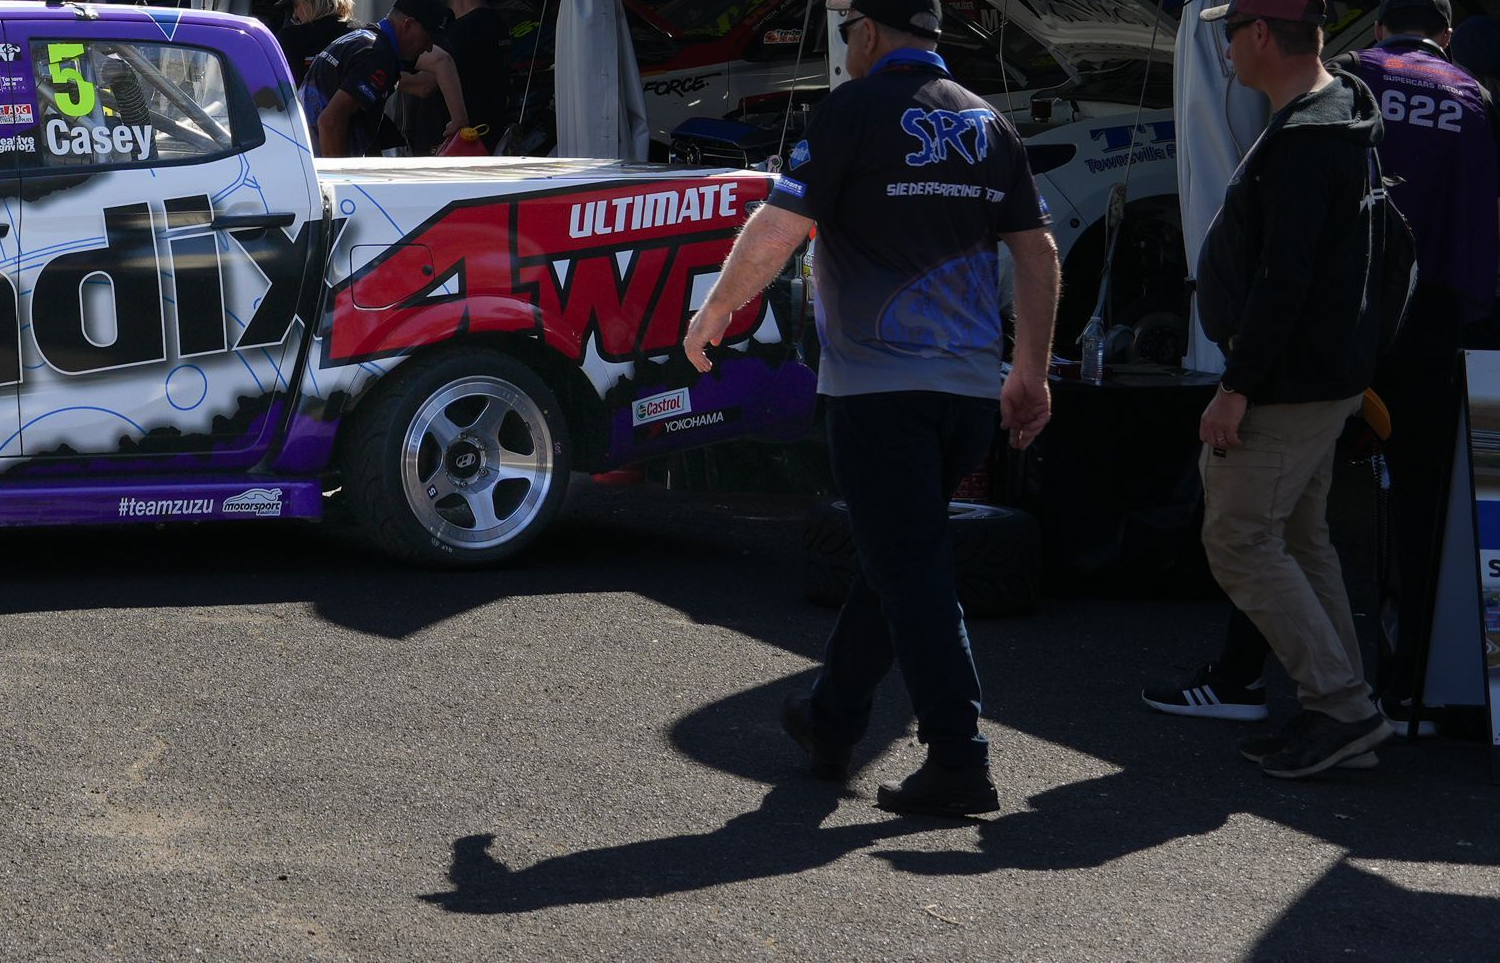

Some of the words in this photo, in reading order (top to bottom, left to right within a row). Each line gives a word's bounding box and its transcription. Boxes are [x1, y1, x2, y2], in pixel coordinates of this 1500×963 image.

[47, 43, 96, 117] 5
[1382, 74, 1436, 89] SUPERCARS
[1437, 84, 1464, 97] MEDIA
[1381, 89, 1464, 133] 622
[46, 119, 153, 161] Casey
[900, 108, 996, 167] SRT
[569, 182, 738, 239] ULTIMATE
[646, 394, 681, 418] Castrol
[664, 412, 725, 433] YOKOHAMA
[118, 497, 214, 516] #teamzuzu
[223, 500, 281, 515] motorsport
